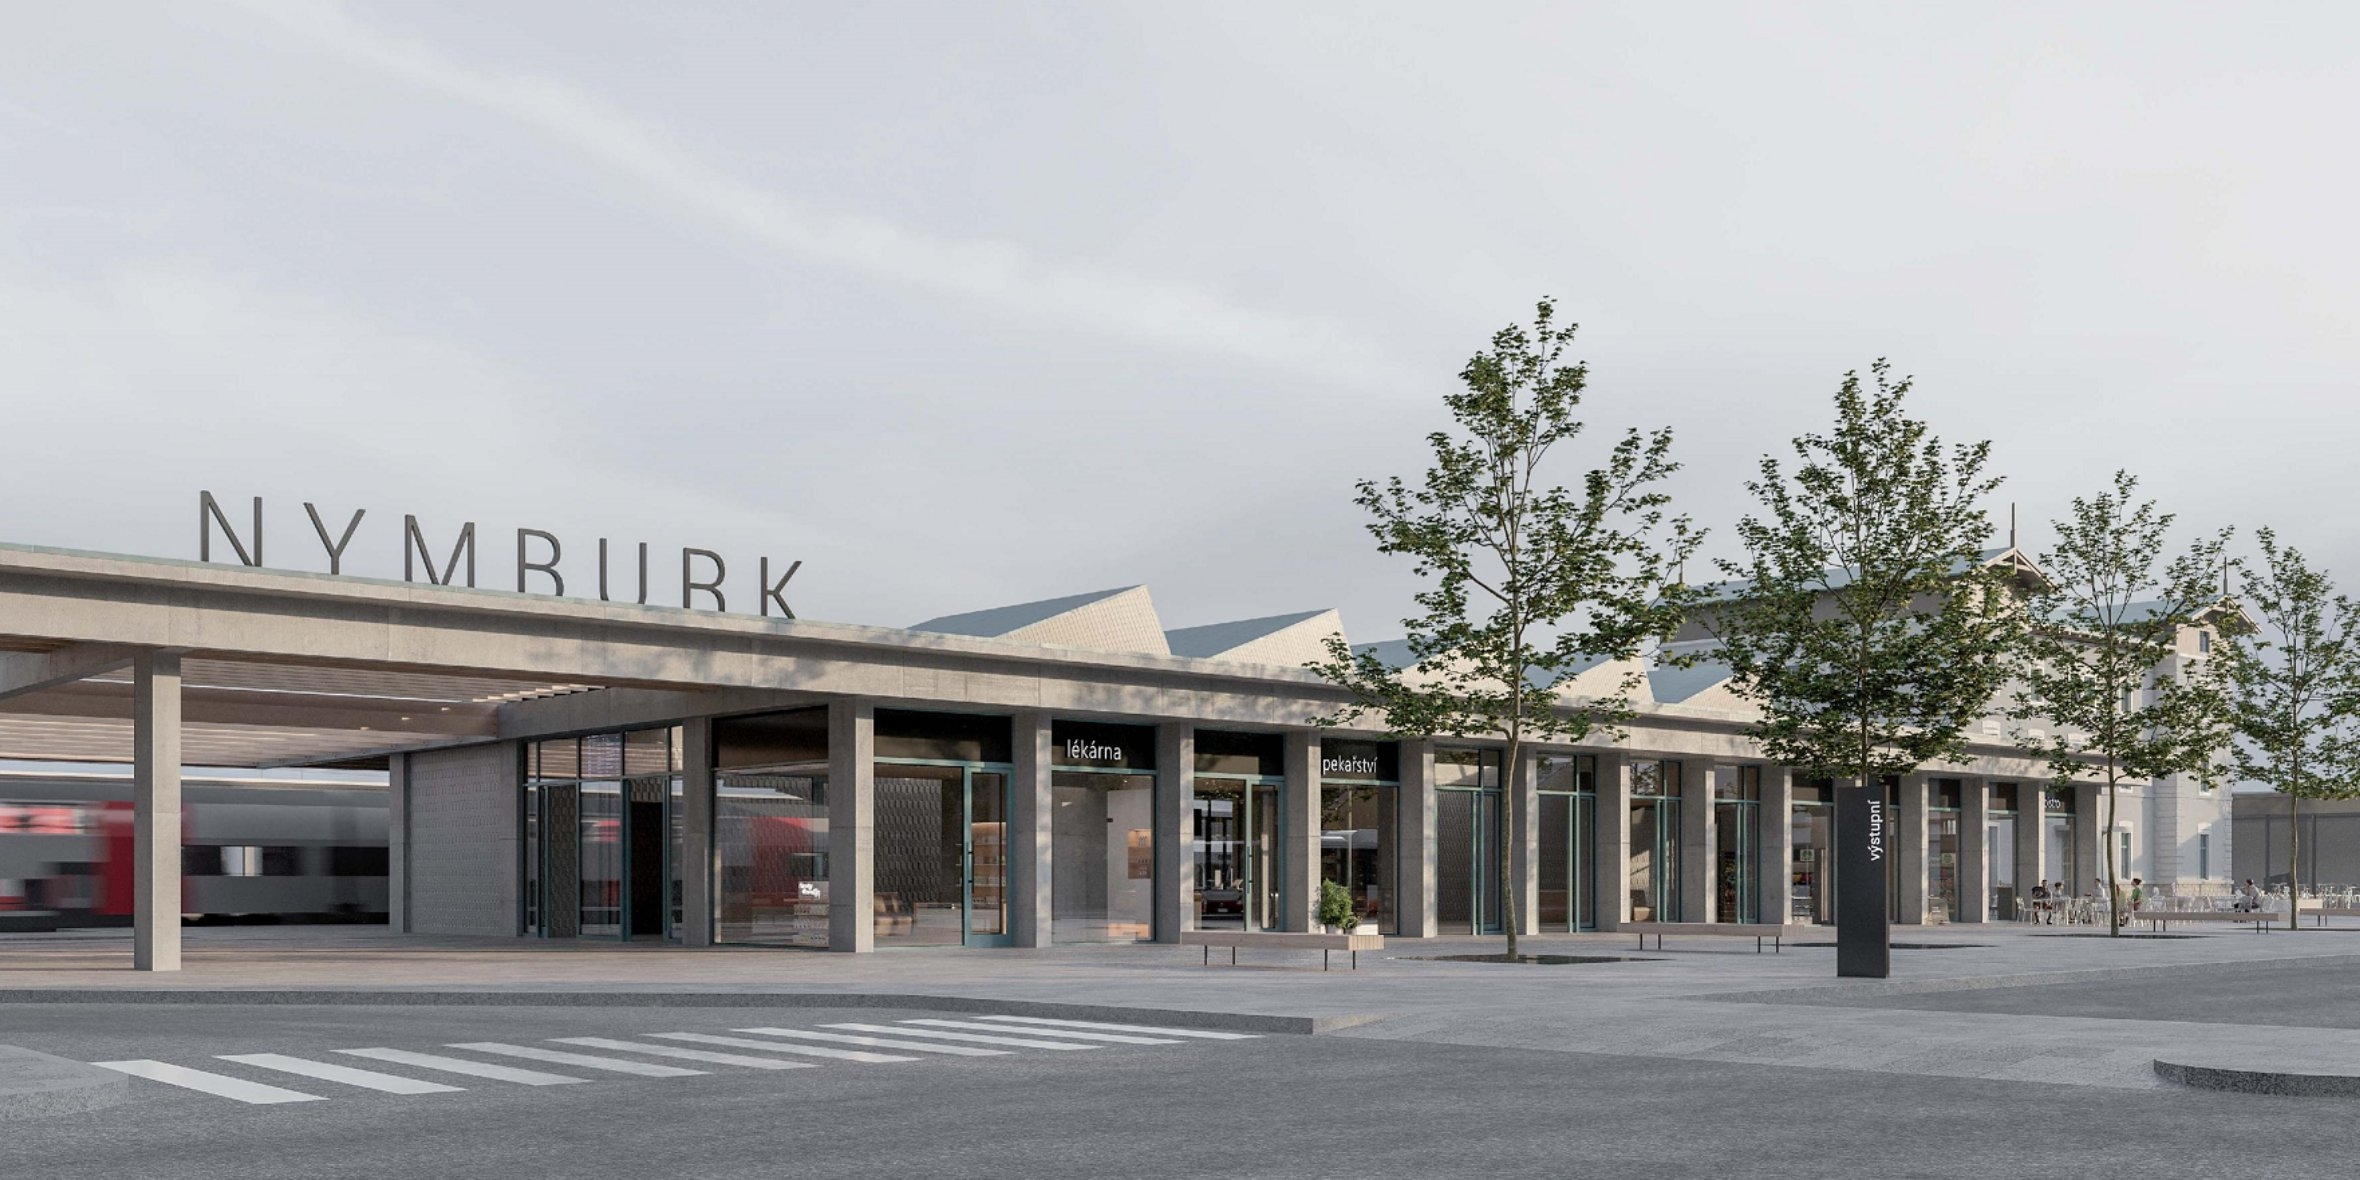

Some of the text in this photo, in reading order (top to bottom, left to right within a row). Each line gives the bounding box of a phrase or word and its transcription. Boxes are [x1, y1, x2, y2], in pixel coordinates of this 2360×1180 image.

[200, 489, 803, 619] NYMBURK
[1067, 739, 1121, 760] lékárna
[1323, 755, 1377, 775] pekařství
[1867, 799, 1883, 861] výstupní
